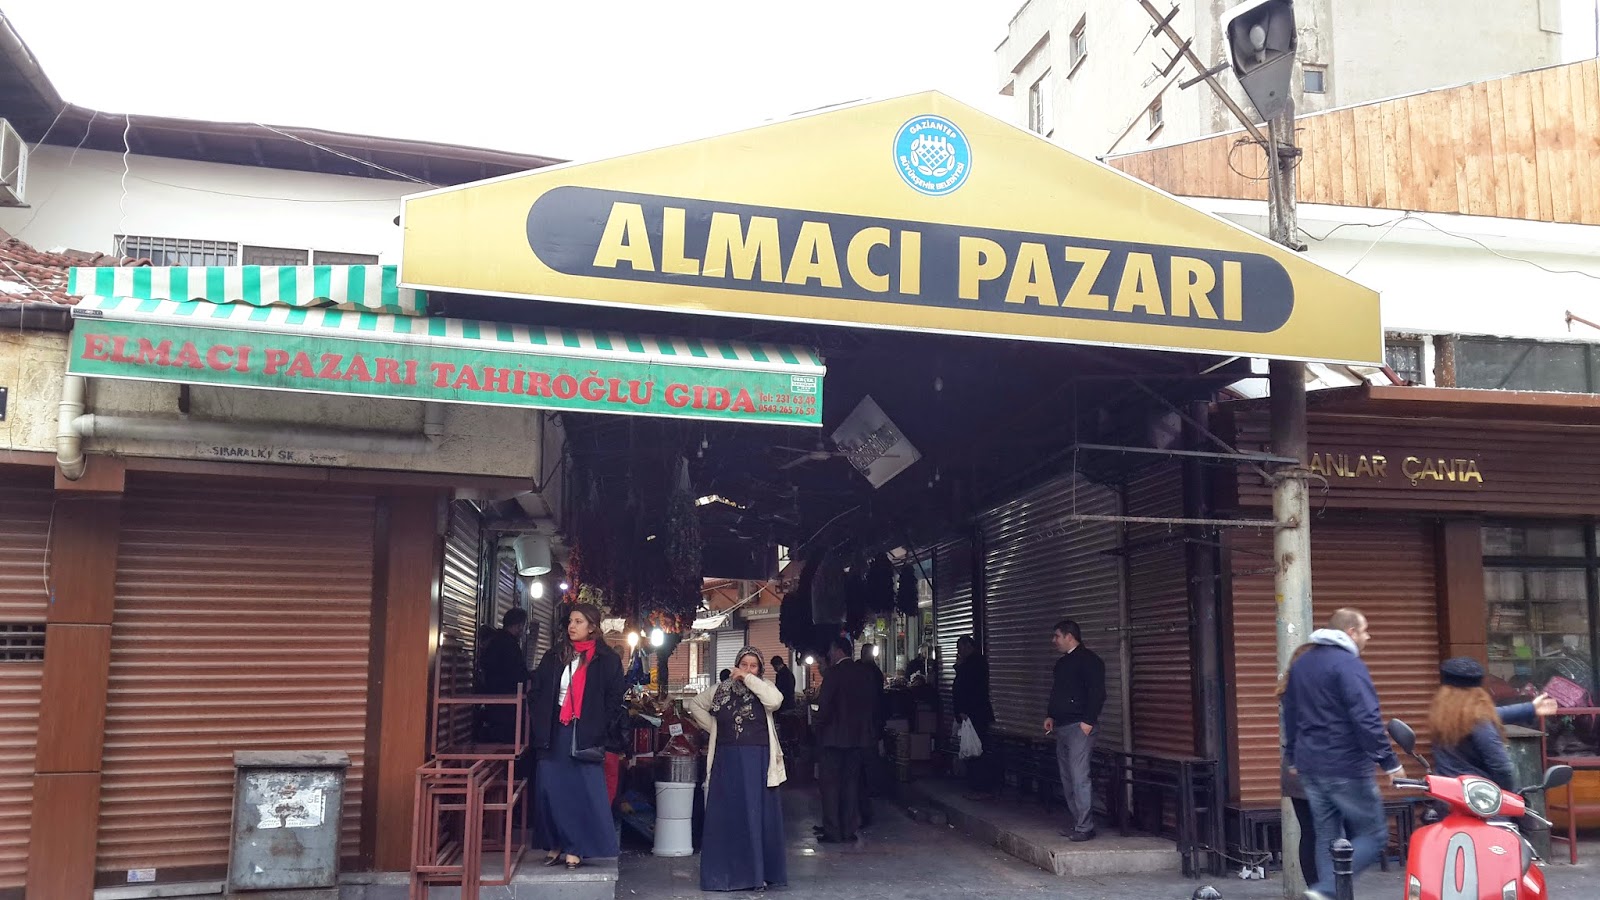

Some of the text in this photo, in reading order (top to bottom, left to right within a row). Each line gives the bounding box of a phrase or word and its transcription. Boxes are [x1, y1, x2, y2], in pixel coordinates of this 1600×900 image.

[909, 120, 957, 139] GAZİANTEP
[593, 201, 1243, 322] ALMACI PAZARI
[81, 334, 757, 413] ELMACI PAZARI TAHİROĞLU GIDA
[759, 392, 816, 405] Tel: 231 63 49
[759, 404, 816, 415] 0543 265 76 59
[1402, 456, 1483, 486] ÇANTA
